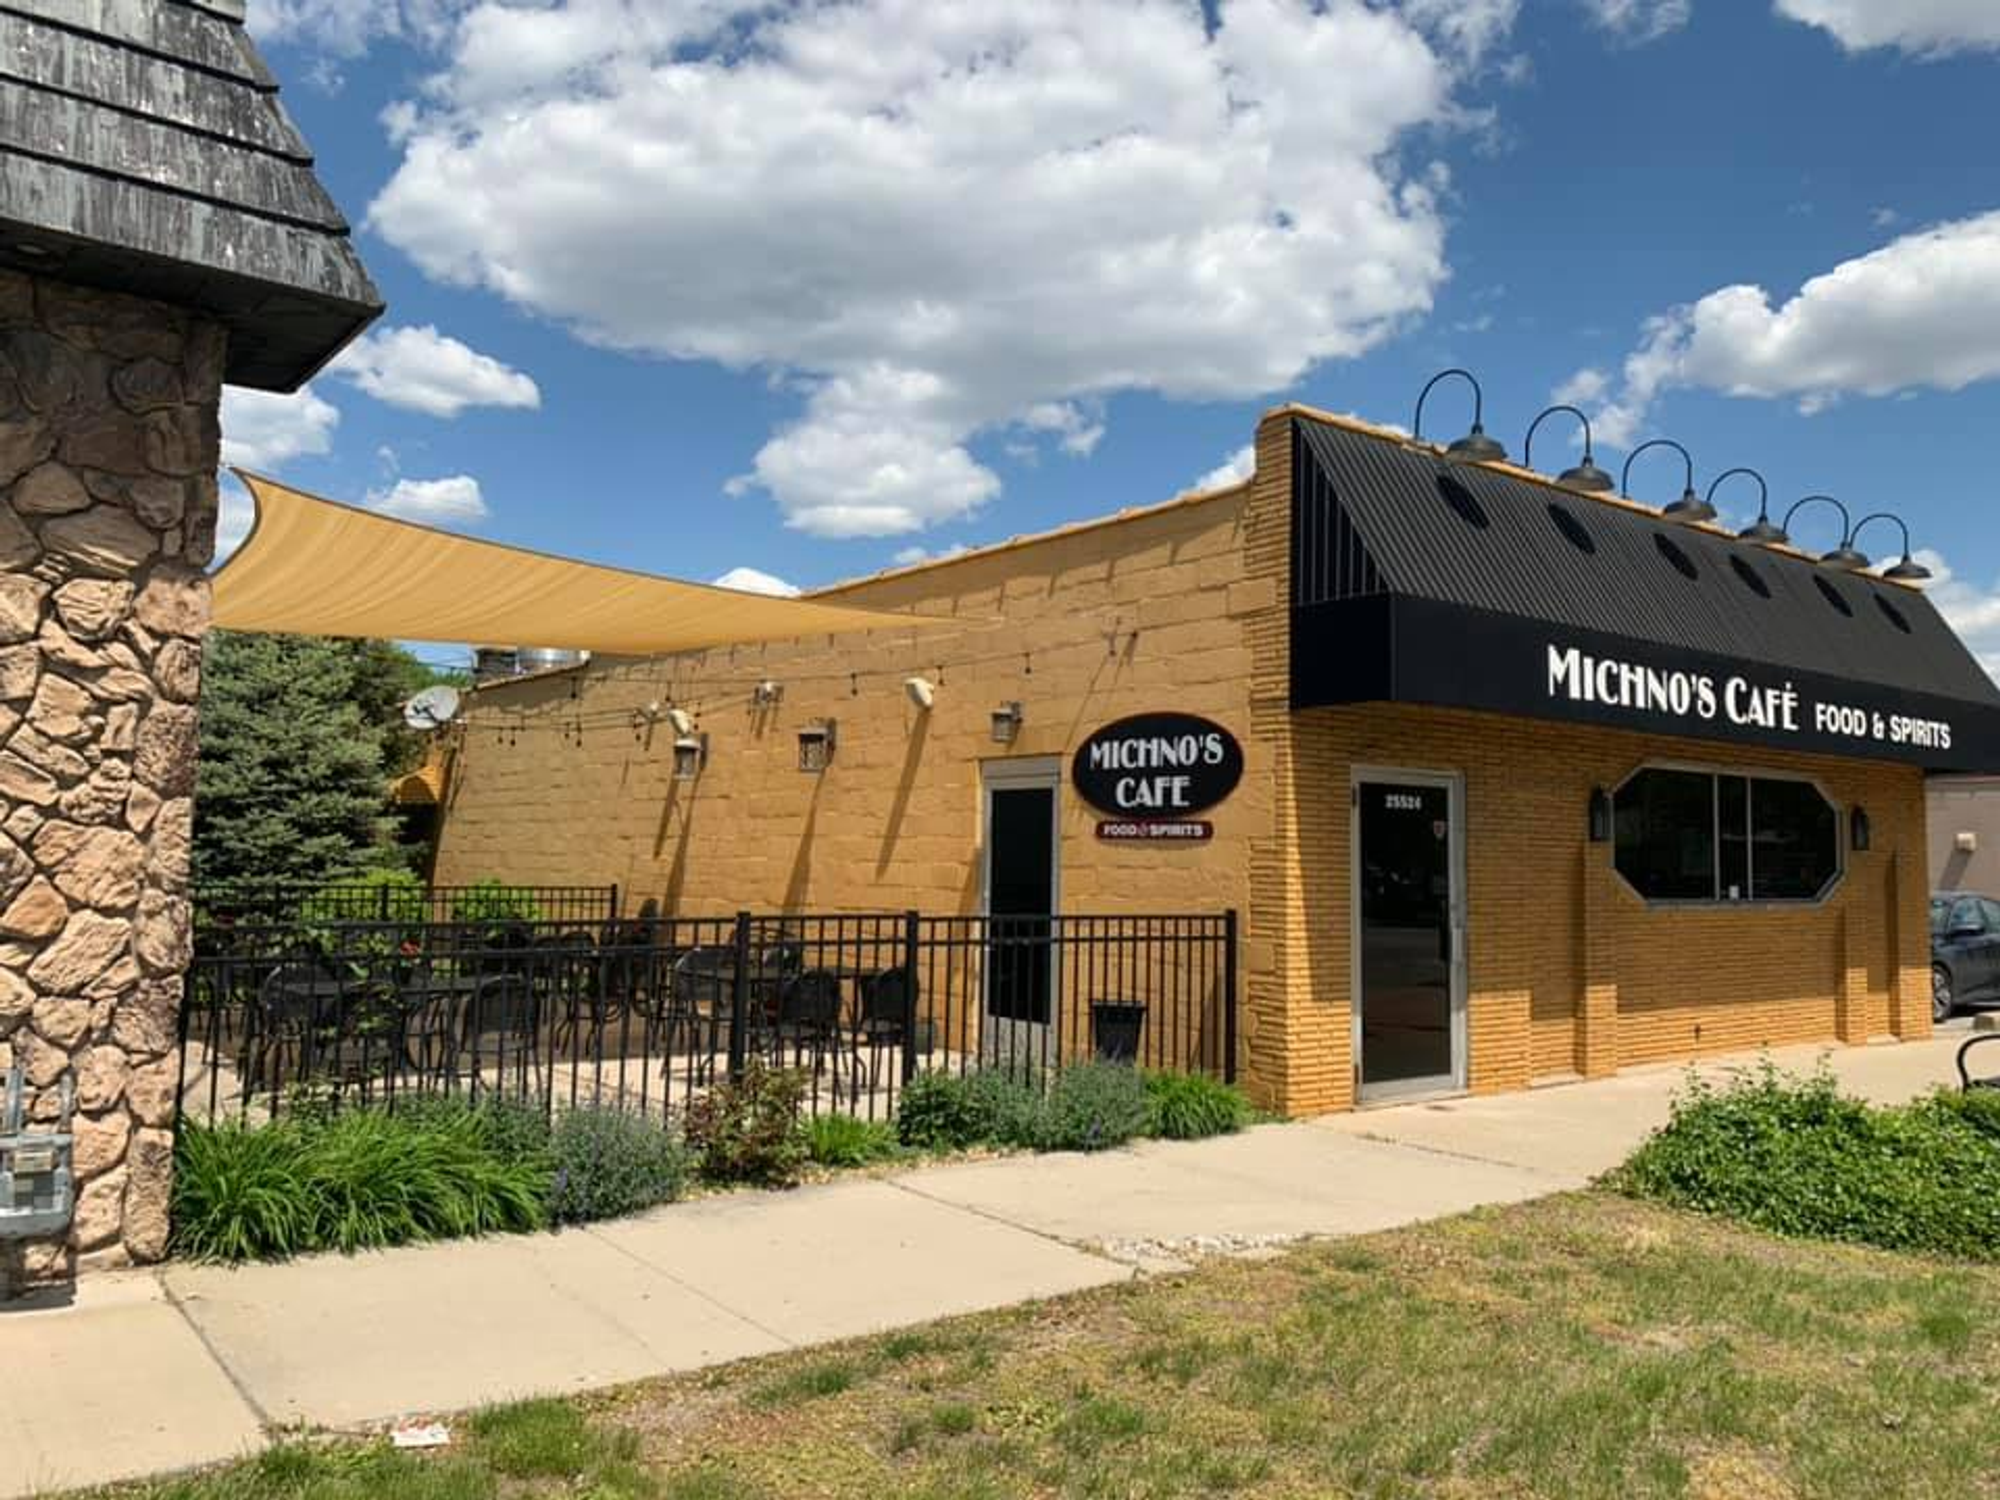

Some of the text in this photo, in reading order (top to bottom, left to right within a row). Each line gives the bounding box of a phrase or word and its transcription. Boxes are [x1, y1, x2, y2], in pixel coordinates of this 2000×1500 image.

[1547, 644, 1952, 750] MICHNO'S CAFÉ FOOD & SPIRITS
[1089, 733, 1225, 770] MICHNO'S
[1115, 775, 1191, 808] CAFE
[1104, 823, 1137, 836] FOOD
[1149, 822, 1204, 836] SPIRITS
